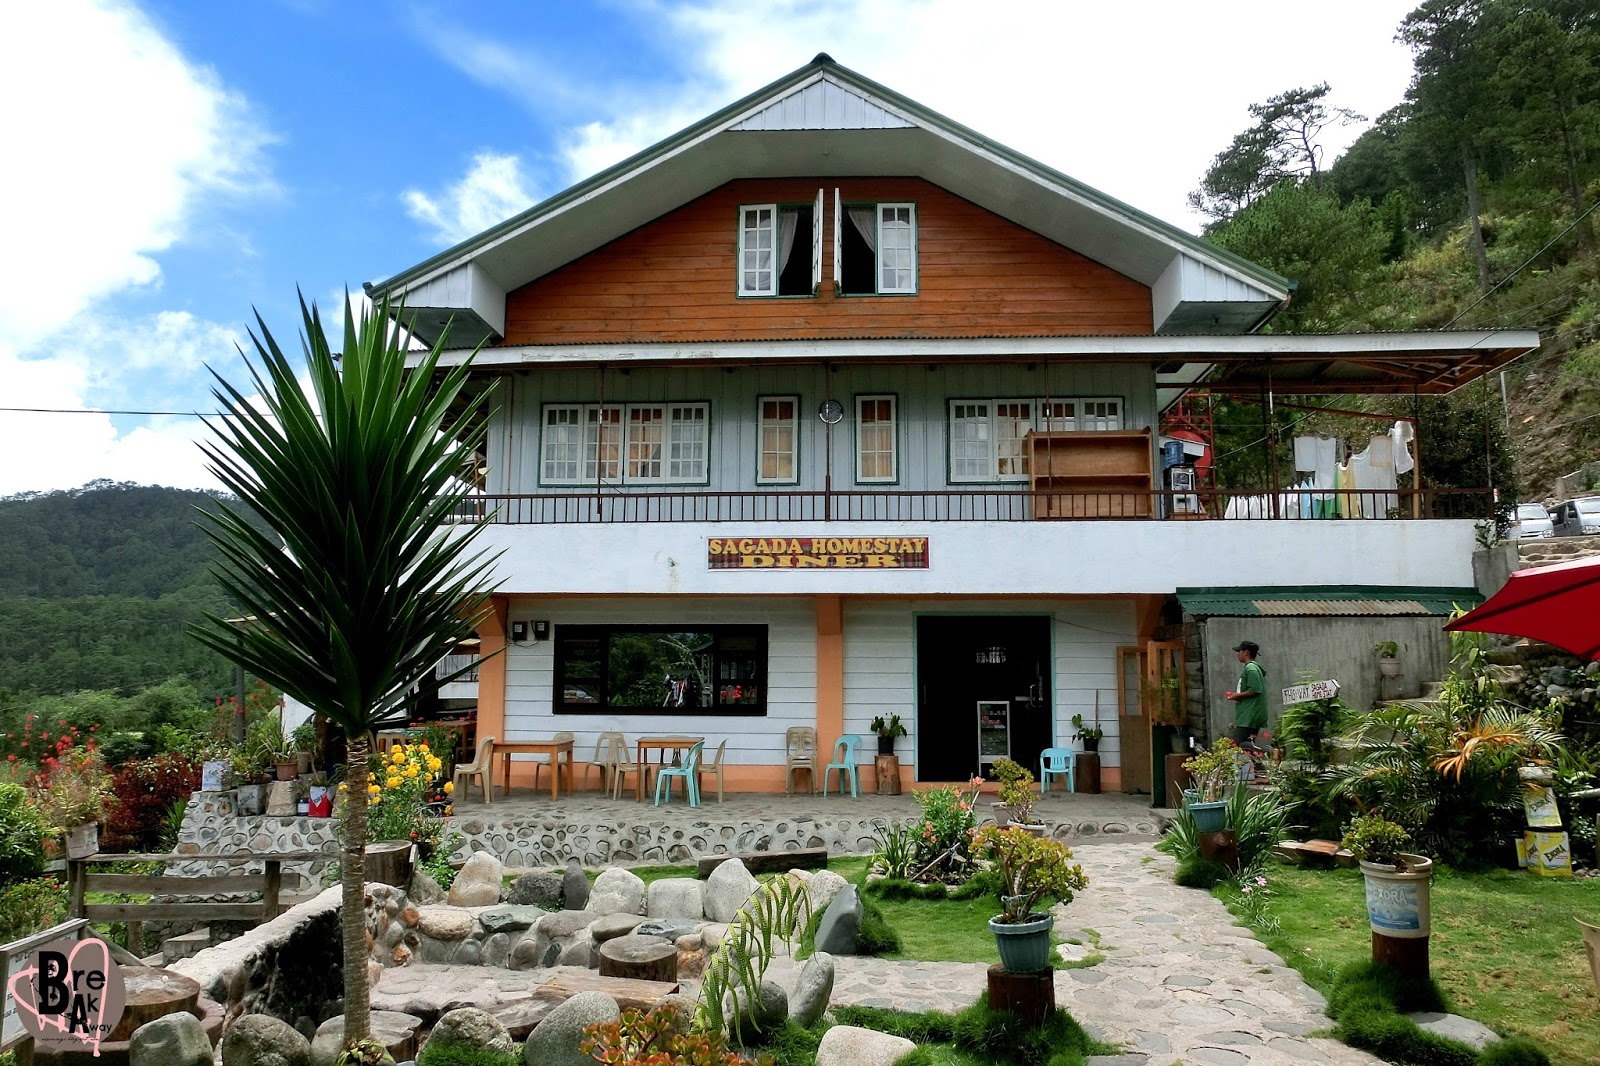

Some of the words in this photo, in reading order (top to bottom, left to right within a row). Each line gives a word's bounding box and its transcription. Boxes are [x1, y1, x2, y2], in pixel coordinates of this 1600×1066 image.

[709, 538, 804, 555] SAGADA
[811, 538, 926, 555] HOMESTAY
[740, 554, 901, 568] DINER
